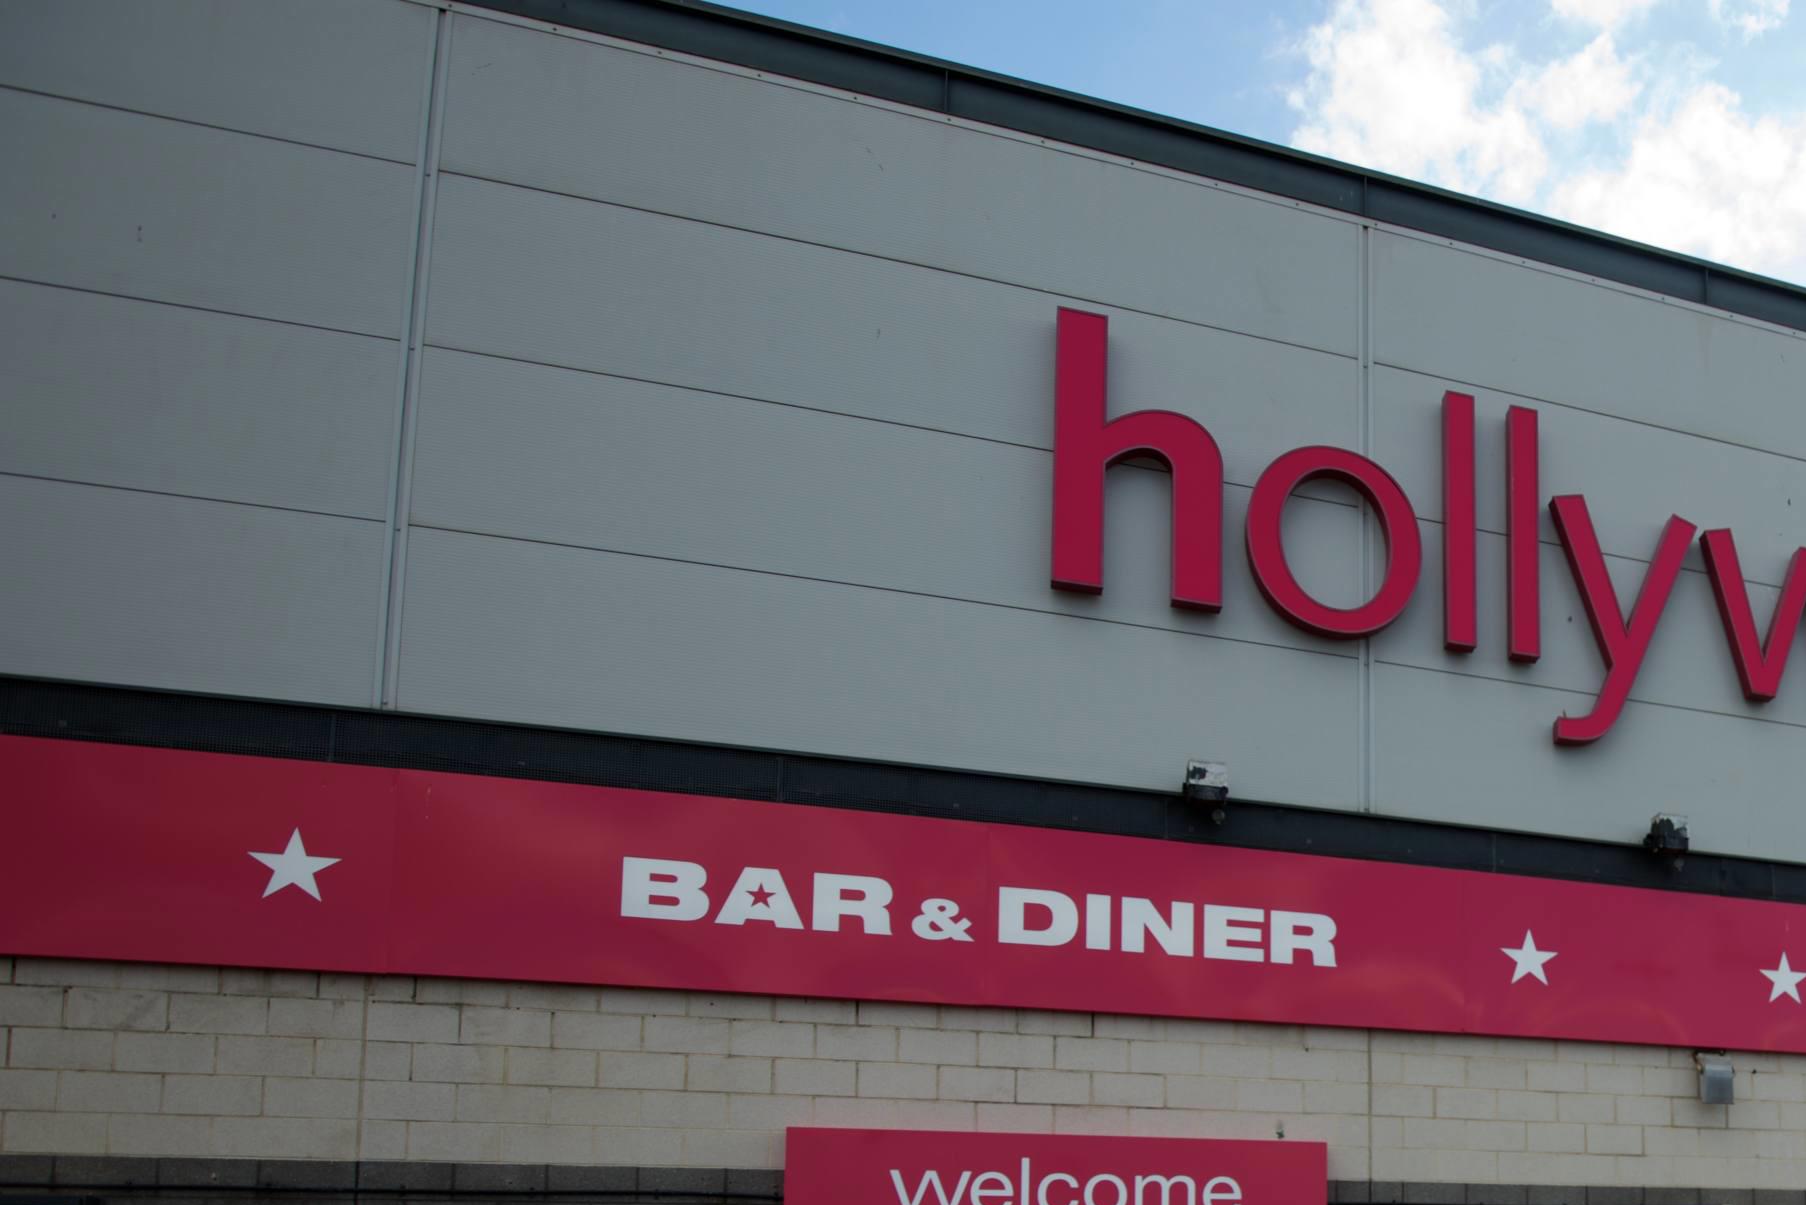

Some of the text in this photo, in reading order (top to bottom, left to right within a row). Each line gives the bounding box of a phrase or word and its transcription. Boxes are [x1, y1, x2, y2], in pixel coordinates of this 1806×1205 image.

[620, 855, 1338, 968] BAR & DINER
